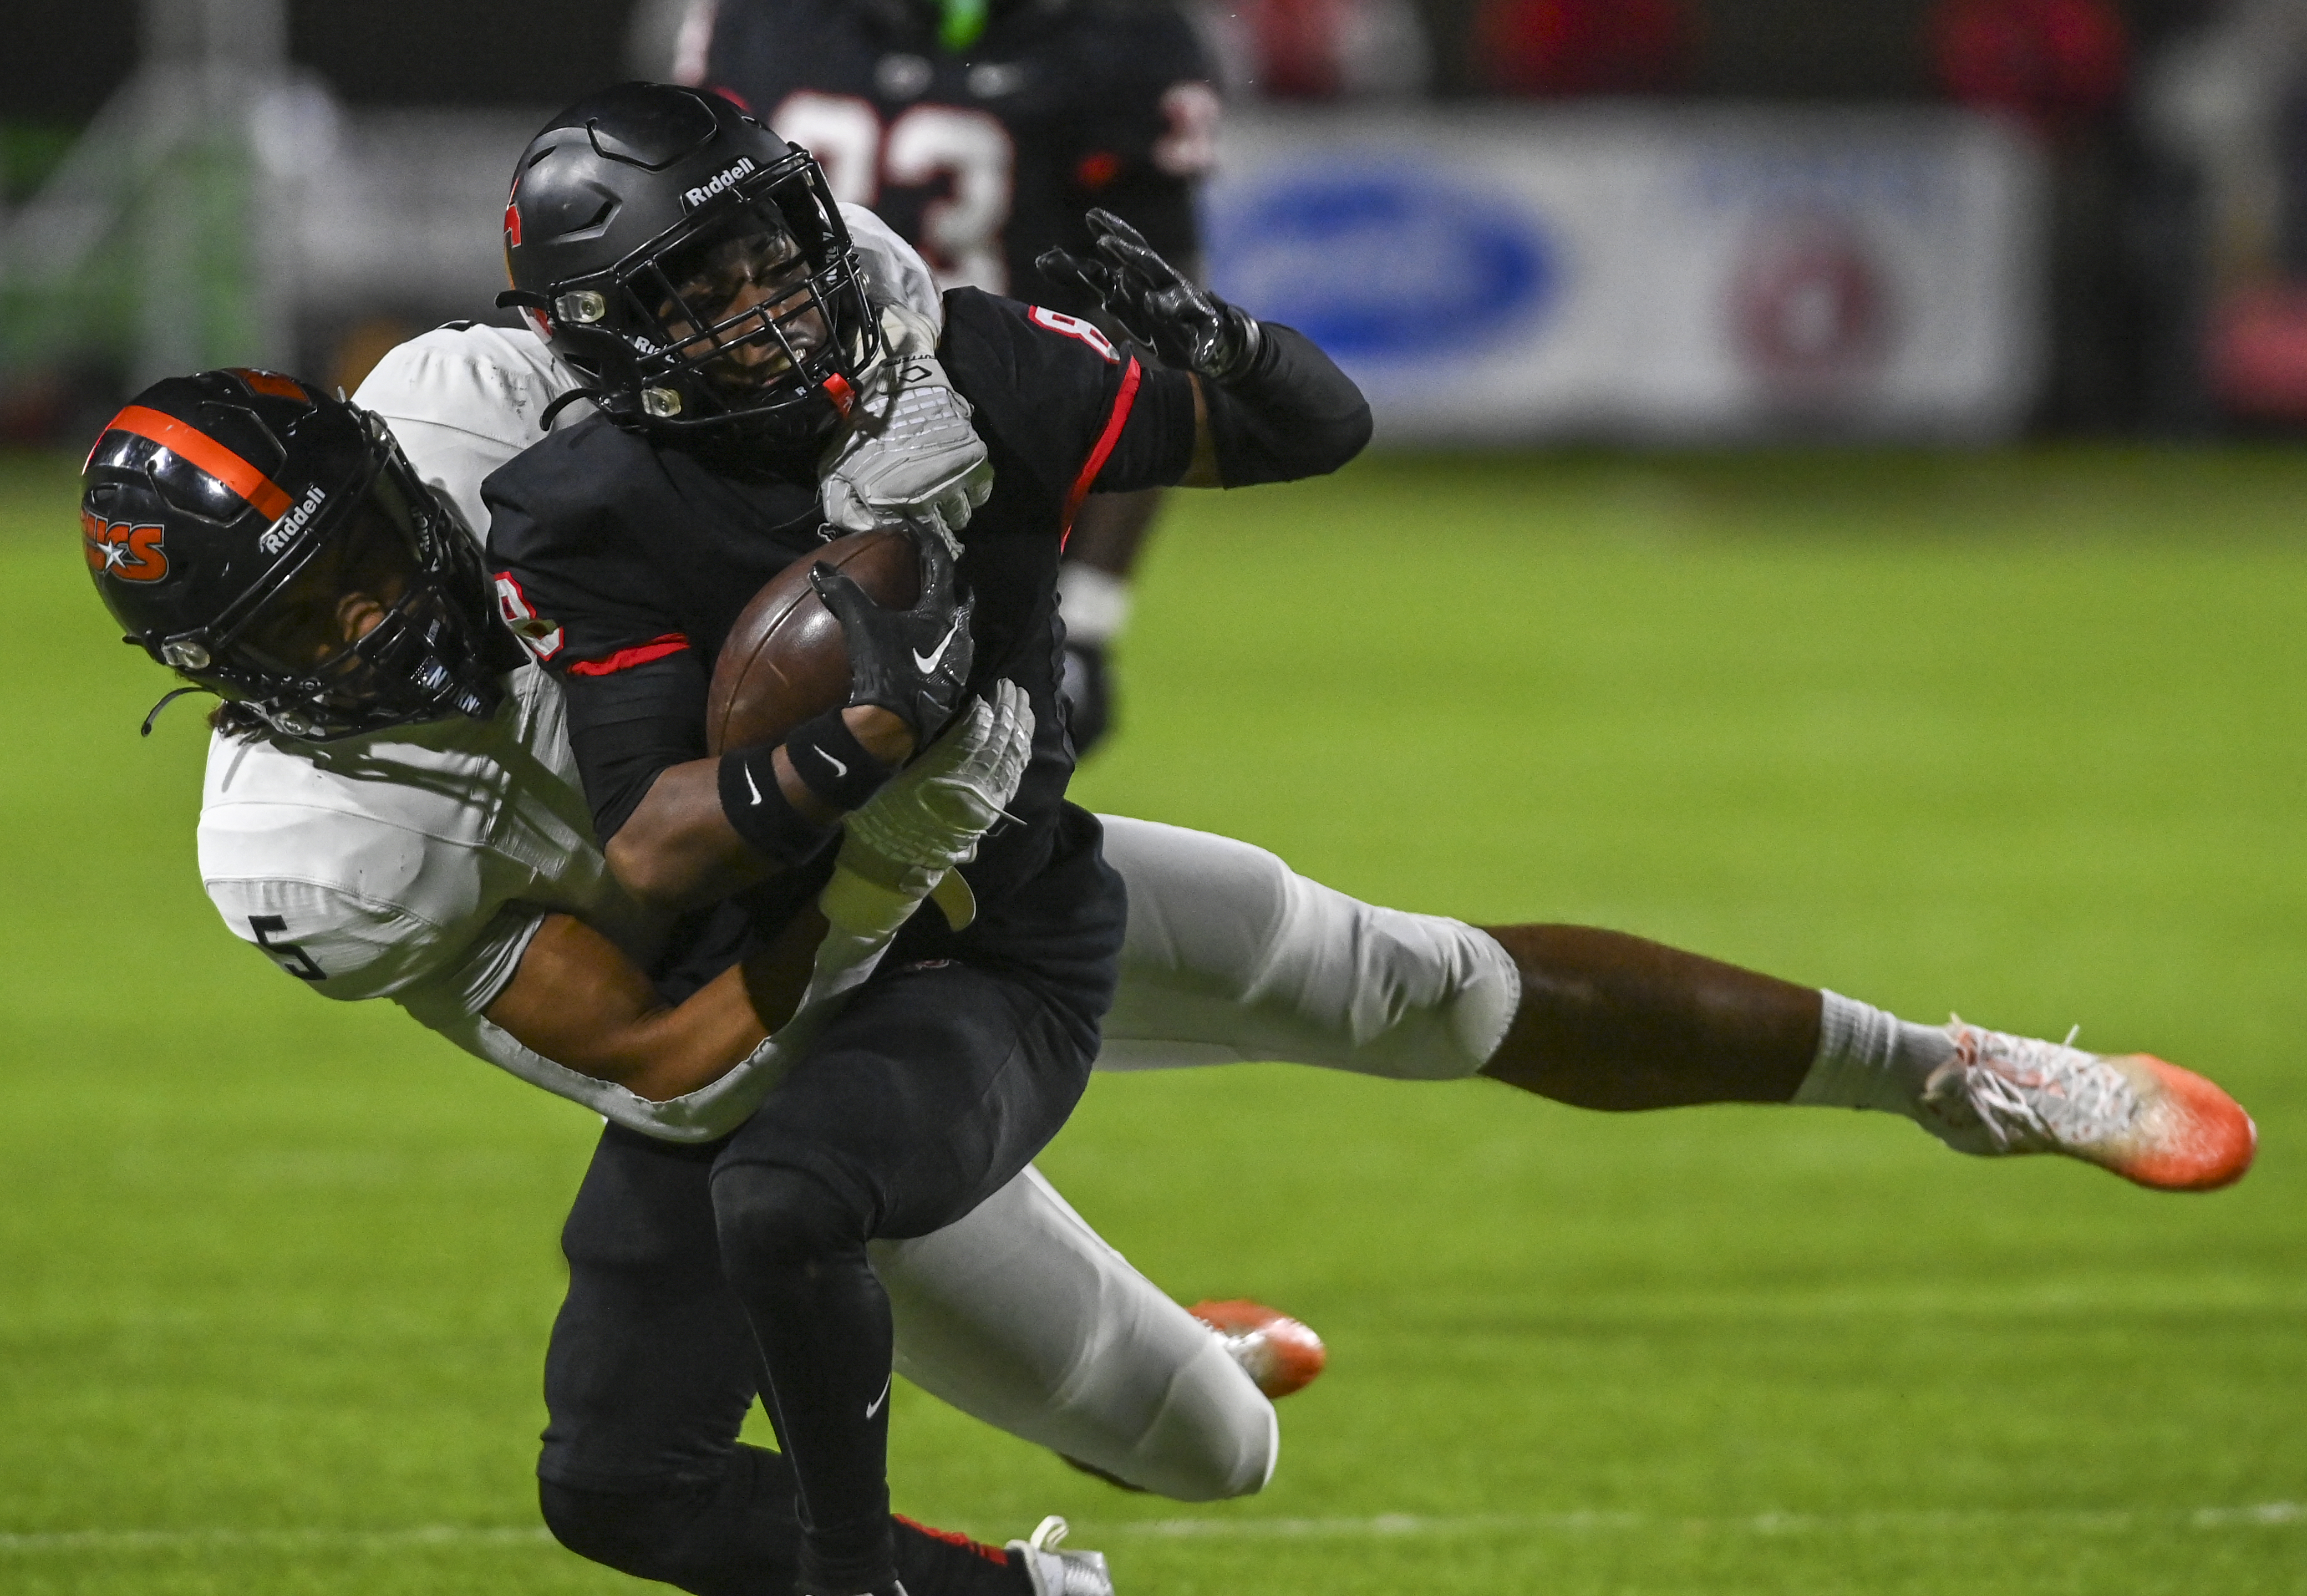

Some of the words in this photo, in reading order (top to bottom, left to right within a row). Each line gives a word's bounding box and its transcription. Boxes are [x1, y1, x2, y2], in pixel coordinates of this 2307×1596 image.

[685, 156, 756, 207] Riddell
[266, 486, 326, 555] Riddell
[493, 571, 565, 662] 8
[247, 914, 327, 981] 5
